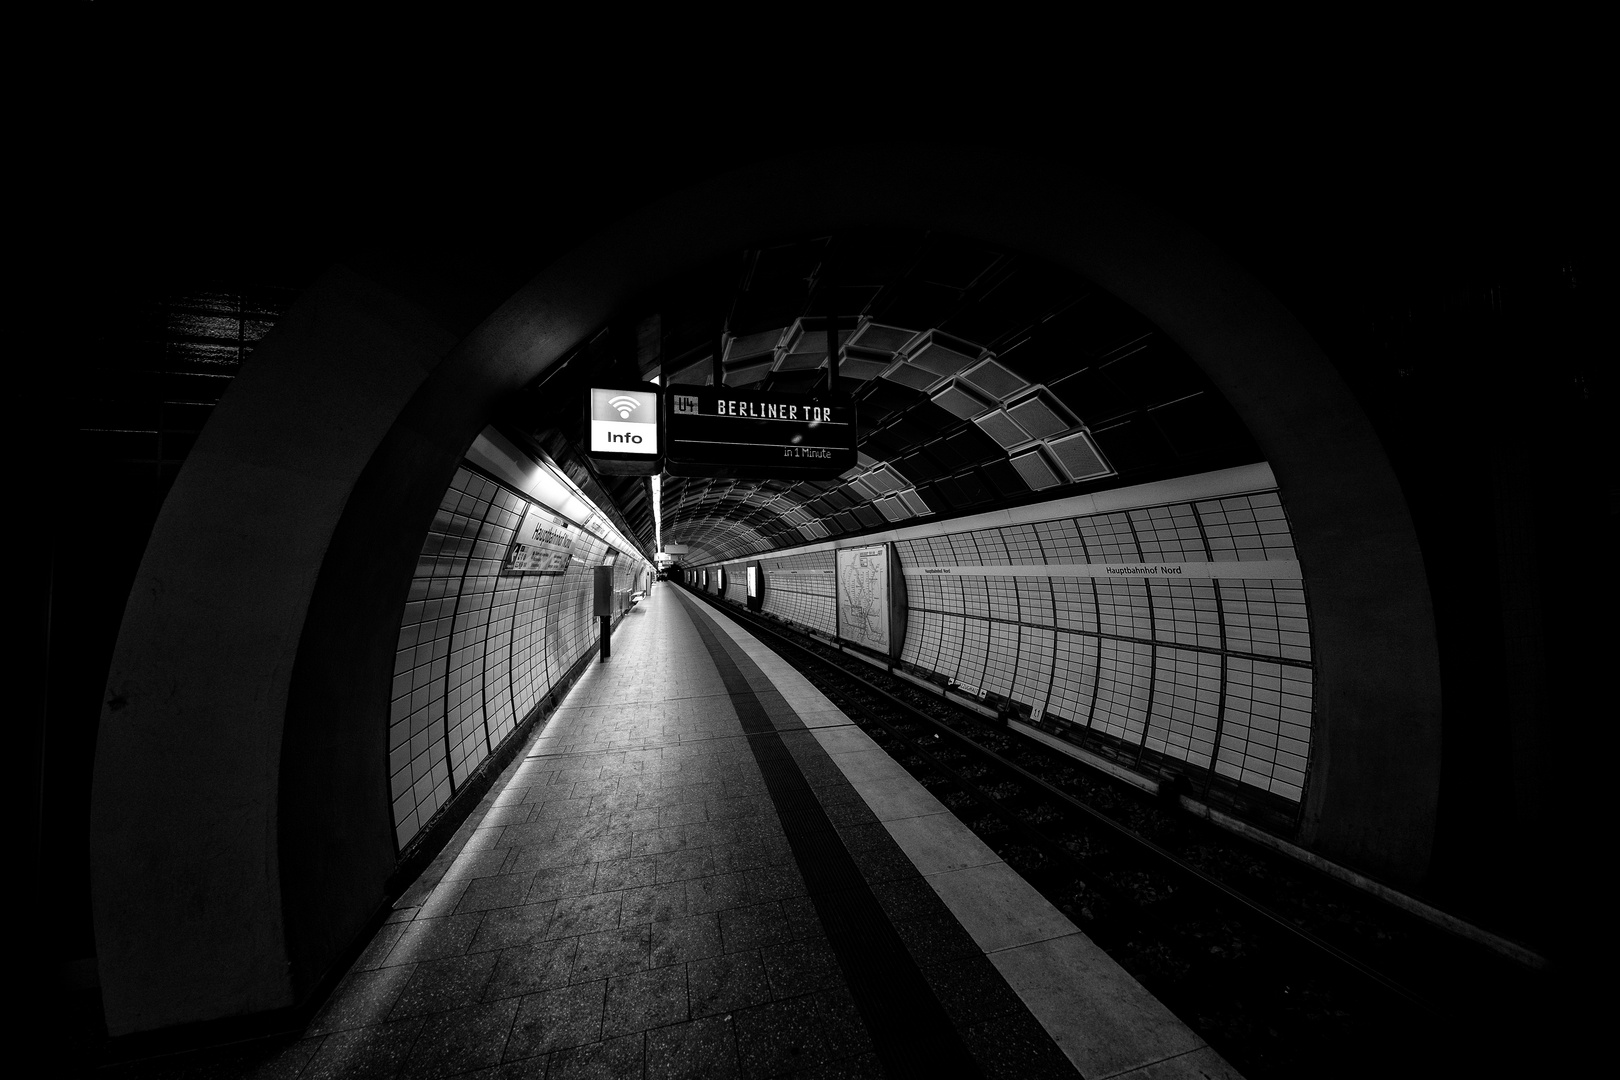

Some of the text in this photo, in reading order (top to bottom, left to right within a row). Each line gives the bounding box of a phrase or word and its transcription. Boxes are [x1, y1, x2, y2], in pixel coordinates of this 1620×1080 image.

[679, 397, 693, 413] U4
[717, 399, 832, 422] BERLINER TOR
[607, 431, 643, 444] Info
[783, 447, 832, 459] in 1 Minute
[1106, 565, 1182, 575] Hauptbahnhof Nord
